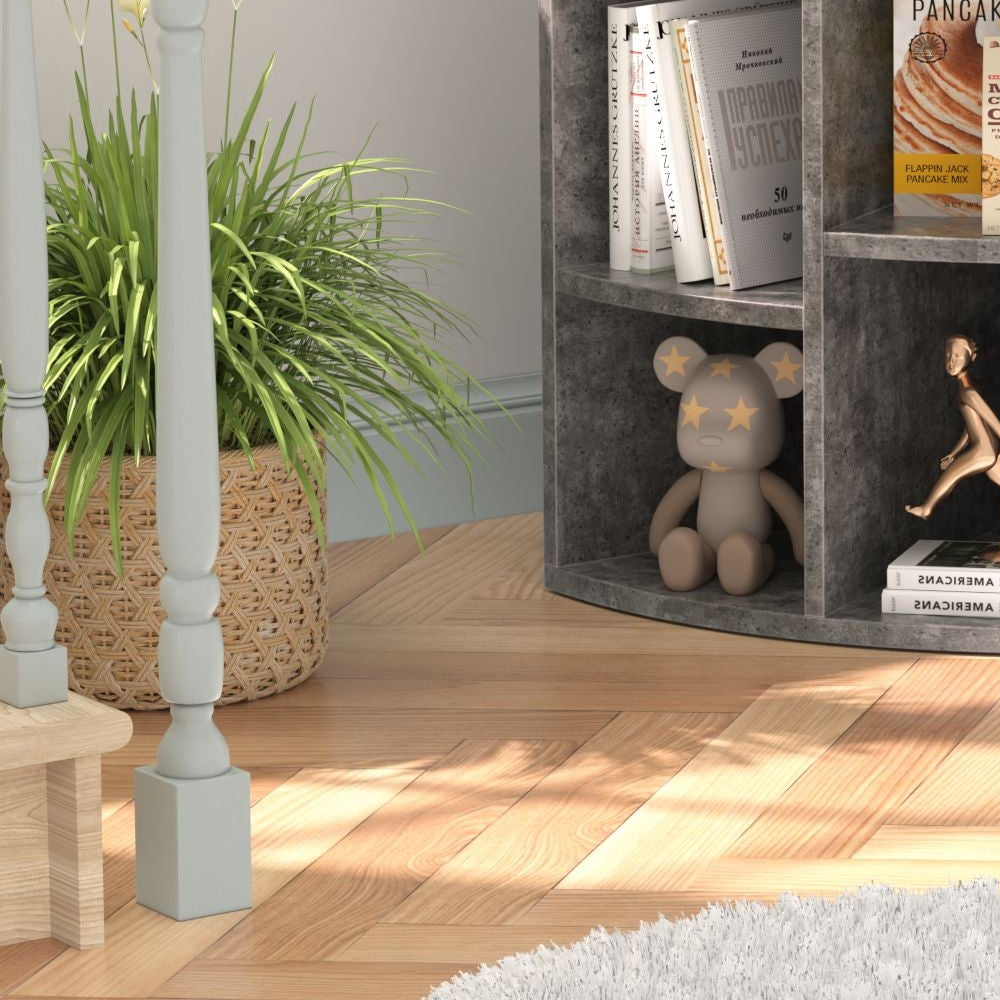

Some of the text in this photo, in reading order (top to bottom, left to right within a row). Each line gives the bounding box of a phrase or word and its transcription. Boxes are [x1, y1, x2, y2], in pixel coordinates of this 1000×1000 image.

[741, 47, 773, 58] Николай
[905, 164, 969, 173] FLAPPIN JACK
[612, 124, 620, 233] JOHANNES
[906, 175, 969, 184] PANCAKE MIX
[774, 186, 788, 203] 50
[741, 205, 795, 221] необходимых
